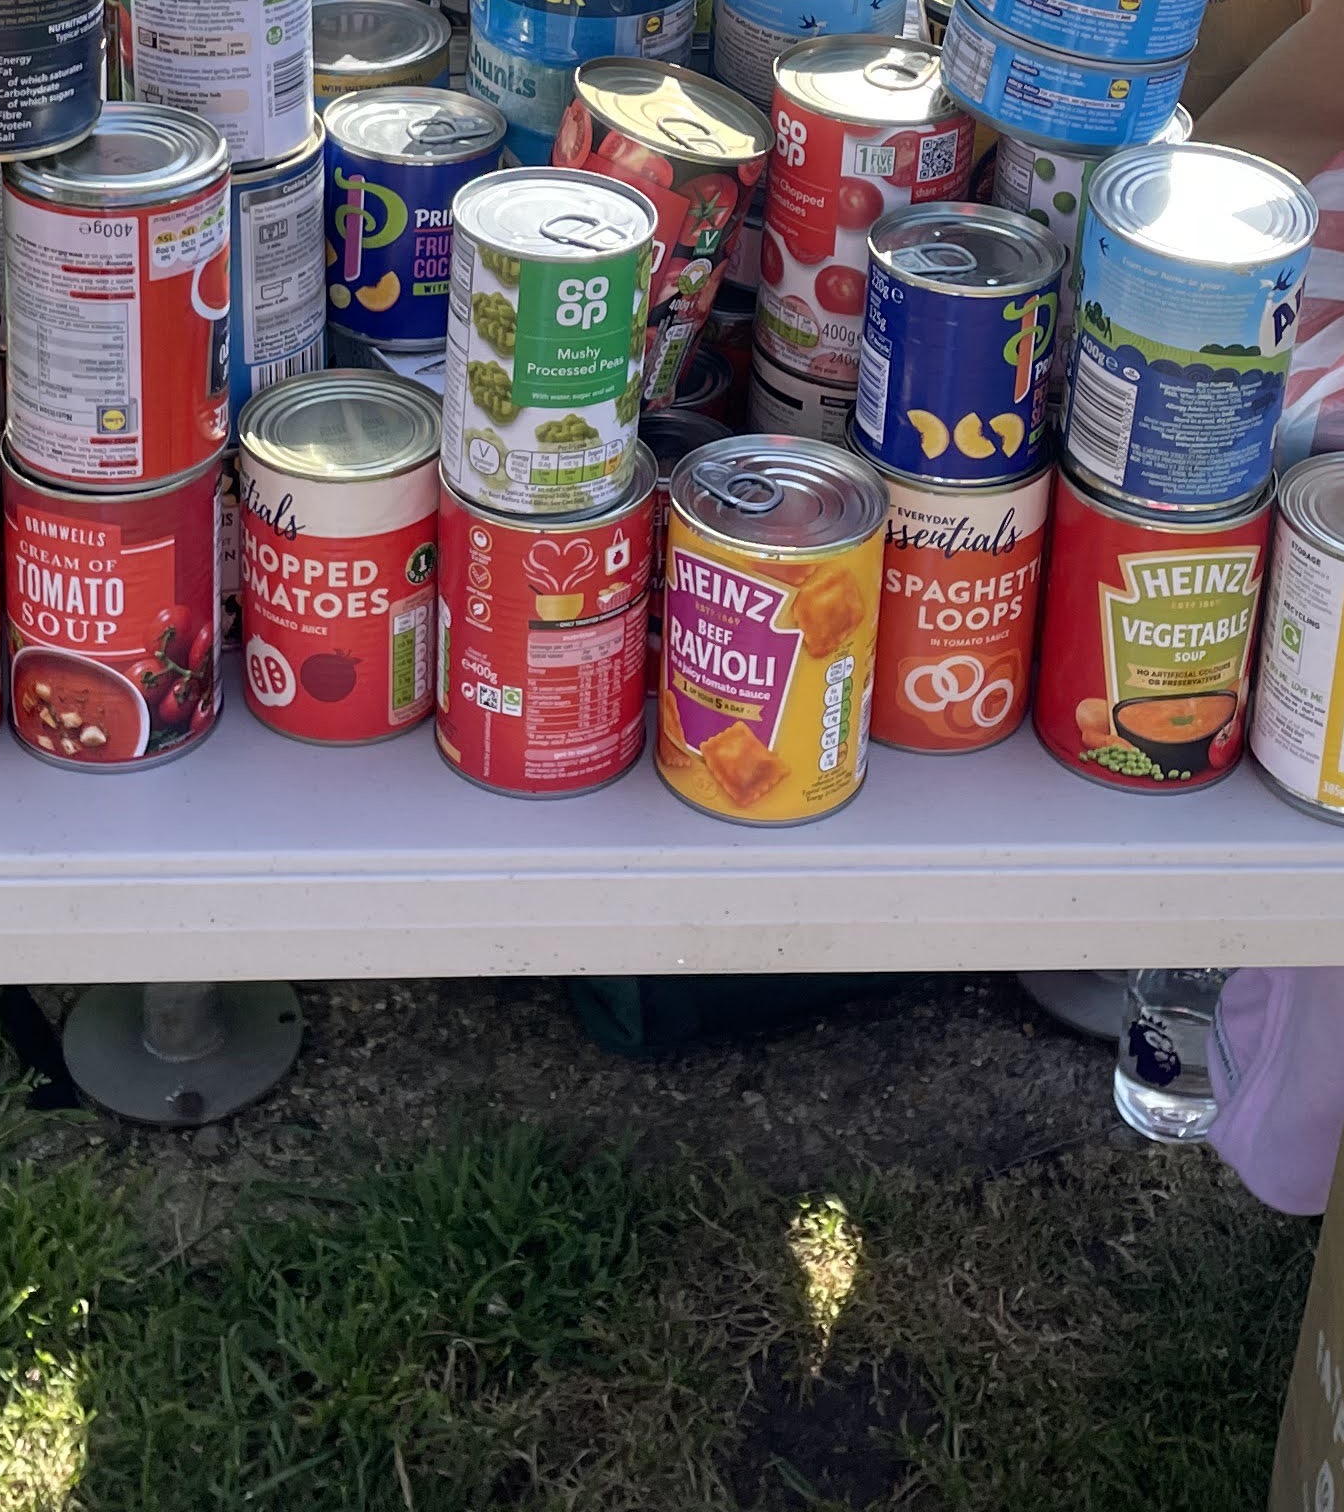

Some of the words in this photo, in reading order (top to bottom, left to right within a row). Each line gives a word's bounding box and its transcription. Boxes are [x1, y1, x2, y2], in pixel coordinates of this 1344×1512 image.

[48, 13, 86, 34] NUTRITION
[8, 76, 19, 86] of
[21, 72, 48, 85] which
[49, 63, 83, 79] saturates
[8, 99, 19, 108] of
[21, 95, 48, 107] which
[49, 88, 74, 102] sugars
[871, 153, 894, 167] FIVE
[779, 180, 825, 207] Chopped
[915, 188, 936, 198] share
[92, 222, 134, 238] 400g
[869, 304, 886, 331] 125g
[822, 323, 857, 346] 400g
[527, 356, 596, 377] Processed
[599, 355, 625, 374] Peas
[557, 345, 601, 362] Mushy
[898, 506, 956, 526] EVERYDAY
[24, 515, 106, 548] BRAMWELLS
[19, 541, 84, 570] CREAM
[88, 557, 117, 572] OF
[419, 555, 427, 571] 1
[1292, 540, 1322, 568] STORAGE
[17, 562, 124, 617] TOMATO
[678, 559, 775, 623] HEINZ
[1142, 564, 1246, 598] HEINZ
[21, 604, 118, 645] SOUP
[263, 607, 297, 630] TOMATO
[301, 625, 328, 636] JUICE
[918, 595, 1022, 632] LOOPS
[1283, 600, 1321, 630] RECYCLING
[563, 631, 596, 641] nutrition
[698, 619, 733, 643] BEEF
[944, 638, 984, 648] TOMATO
[986, 630, 1010, 643] SAUCE
[1122, 608, 1248, 648] VEGETABLE
[670, 616, 775, 687] RAVIOLI
[1174, 651, 1206, 662] SOUP
[471, 659, 498, 685] 400g
[683, 663, 701, 684] juicy
[702, 675, 736, 695] tomato
[739, 689, 771, 701] sauce
[1151, 669, 1197, 678] ARTIFICIAL
[1199, 661, 1231, 676] COLOURS
[1162, 673, 1221, 686] PRESERVATIVES
[682, 680, 688, 692] 1
[715, 699, 723, 709] 5
[729, 704, 745, 714] DAY
